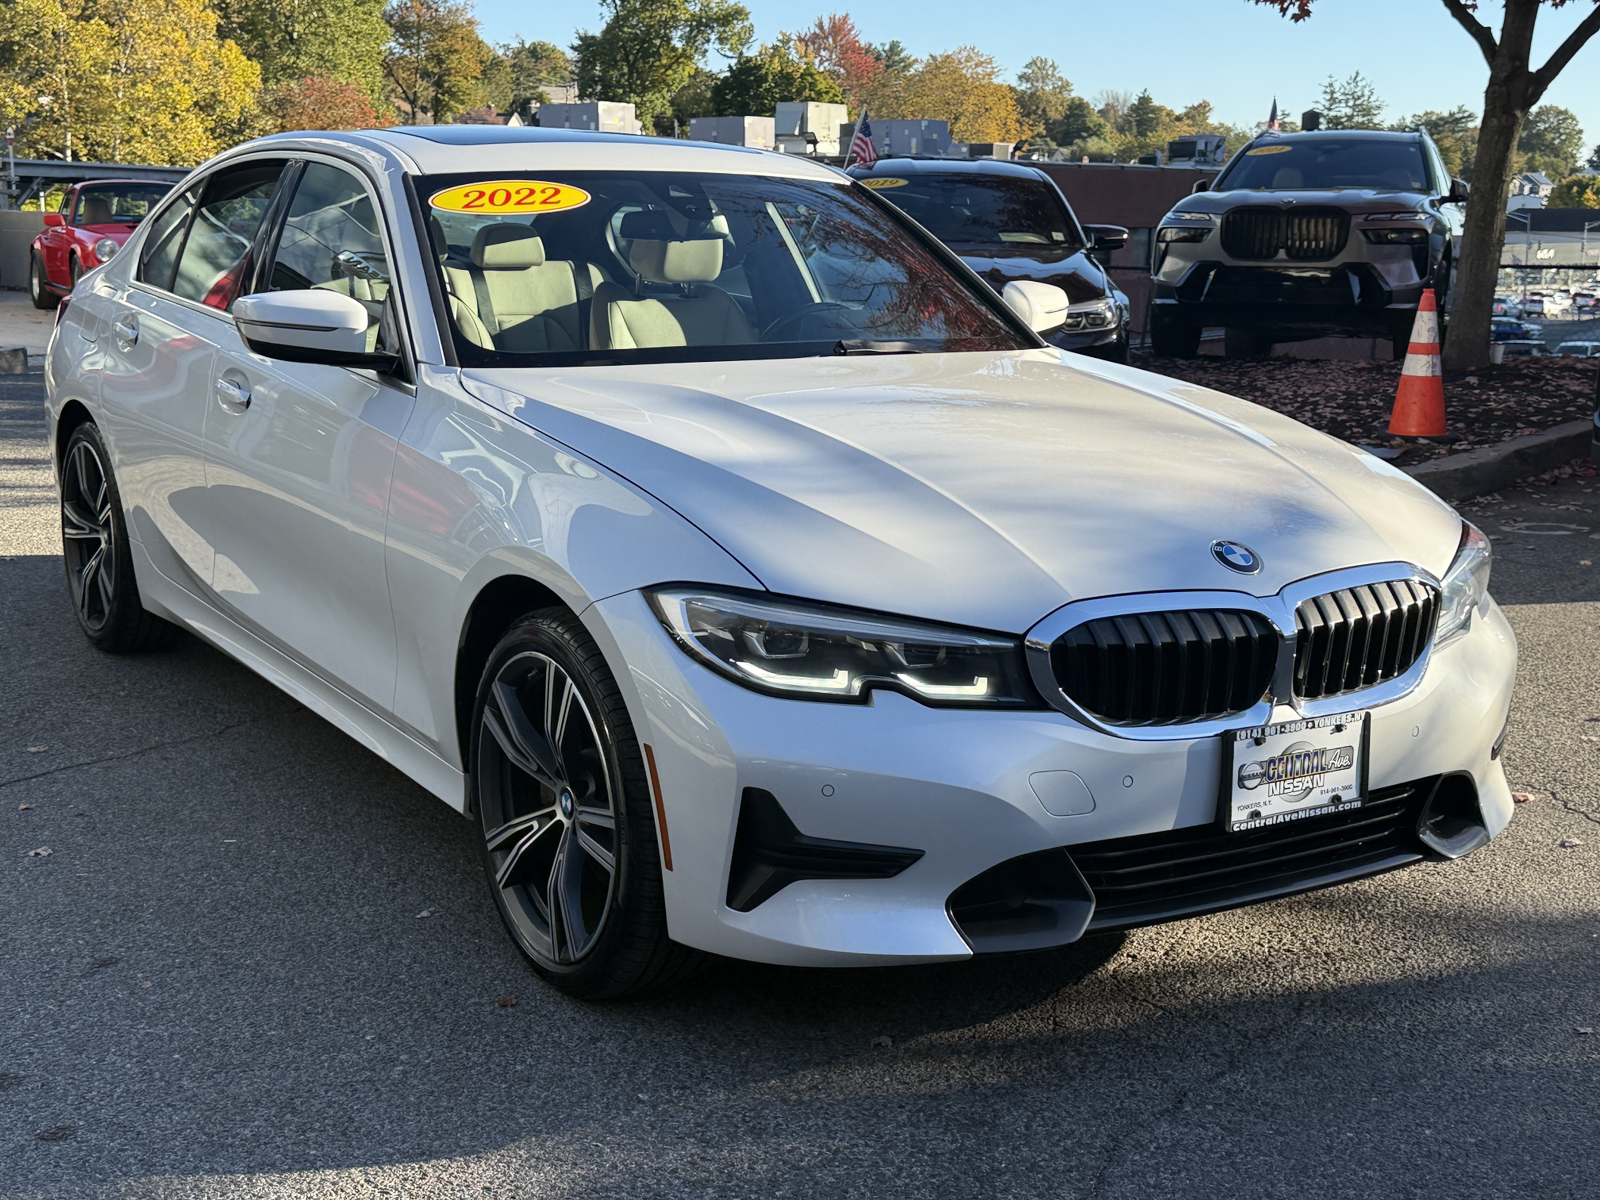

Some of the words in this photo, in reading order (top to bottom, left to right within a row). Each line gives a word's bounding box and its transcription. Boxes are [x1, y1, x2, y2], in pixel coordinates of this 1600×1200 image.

[461, 187, 562, 209] 2022
[1266, 748, 1327, 782] CENTRAL
[1268, 773, 1326, 798] NISSAN
